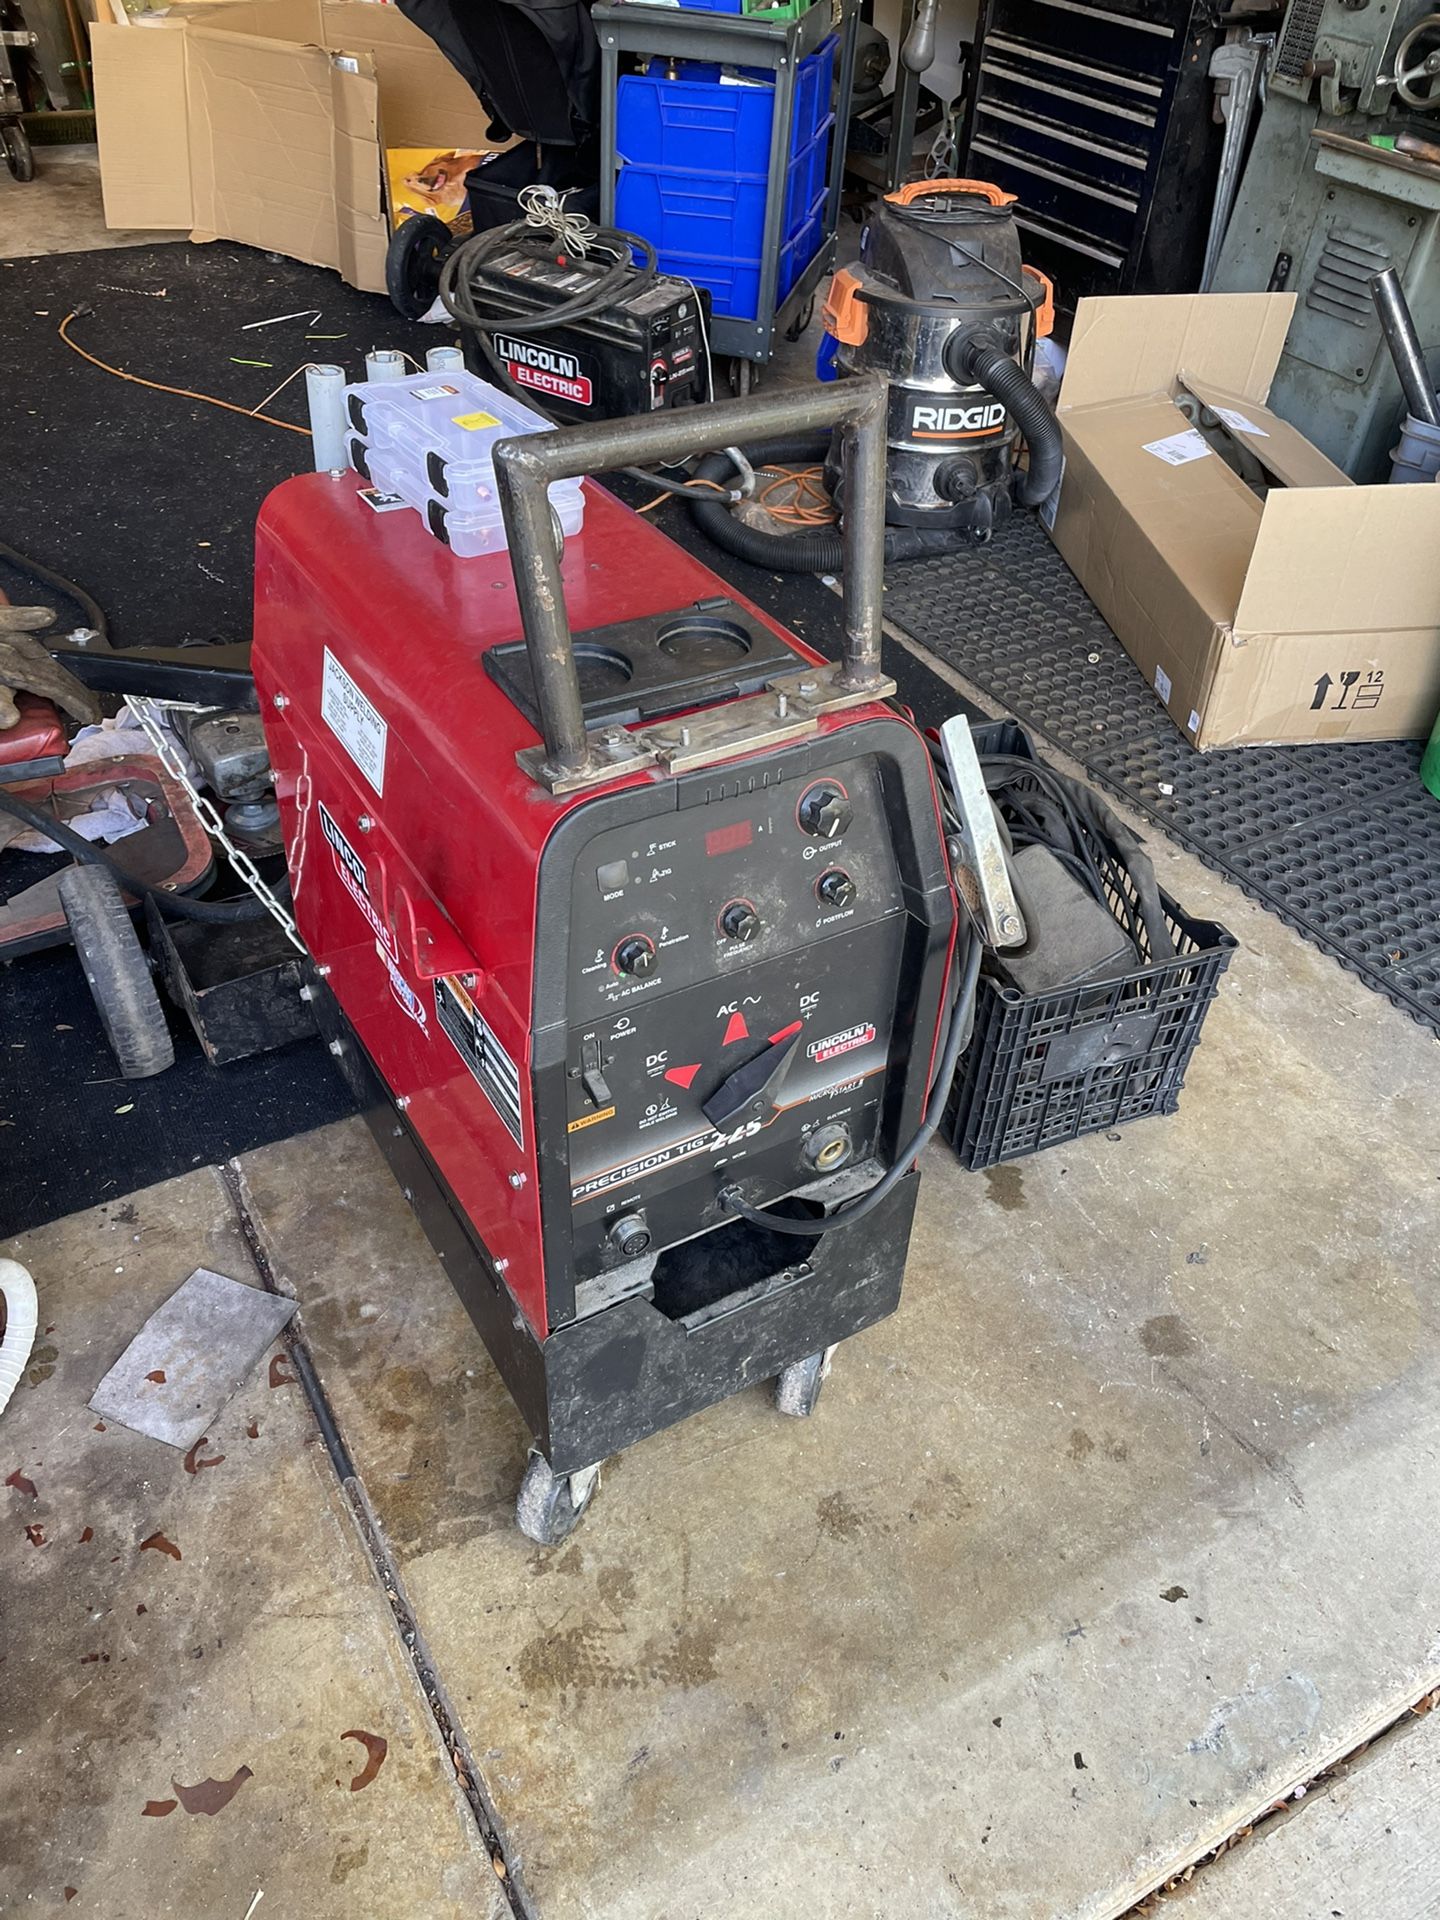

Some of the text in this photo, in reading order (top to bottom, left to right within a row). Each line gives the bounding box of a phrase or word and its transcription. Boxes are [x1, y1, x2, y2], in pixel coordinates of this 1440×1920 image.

[499, 339, 574, 378] LINCOLN
[517, 366, 583, 399] ELECTRIC
[912, 403, 1006, 430] RIDGID
[1366, 670, 1384, 683] 12
[328, 661, 354, 700] JACKSON
[354, 694, 382, 735] WELDING
[342, 692, 365, 726] SUPPLY
[322, 812, 370, 896] LINCOL
[658, 840, 677, 851] STICK
[819, 839, 843, 853] OUTPUT
[603, 889, 625, 902] MODE
[339, 859, 392, 950] ELECTRIC
[823, 909, 854, 925] POSTFLOW
[658, 934, 689, 949] Penetration
[581, 962, 607, 975] Cleaning
[605, 981, 619, 990] Auto
[621, 977, 662, 997] AC BALANCE
[800, 991, 820, 1008] DC
[716, 1001, 738, 1018] AC
[583, 1032, 595, 1041] ON
[610, 1027, 637, 1041] POWER
[810, 1025, 865, 1054] LINCOLN
[822, 1034, 869, 1058] ELECTRIC
[646, 1050, 668, 1067] DC
[580, 1109, 614, 1126] WARNING
[572, 1116, 762, 1198] PRECISION TIG 225
